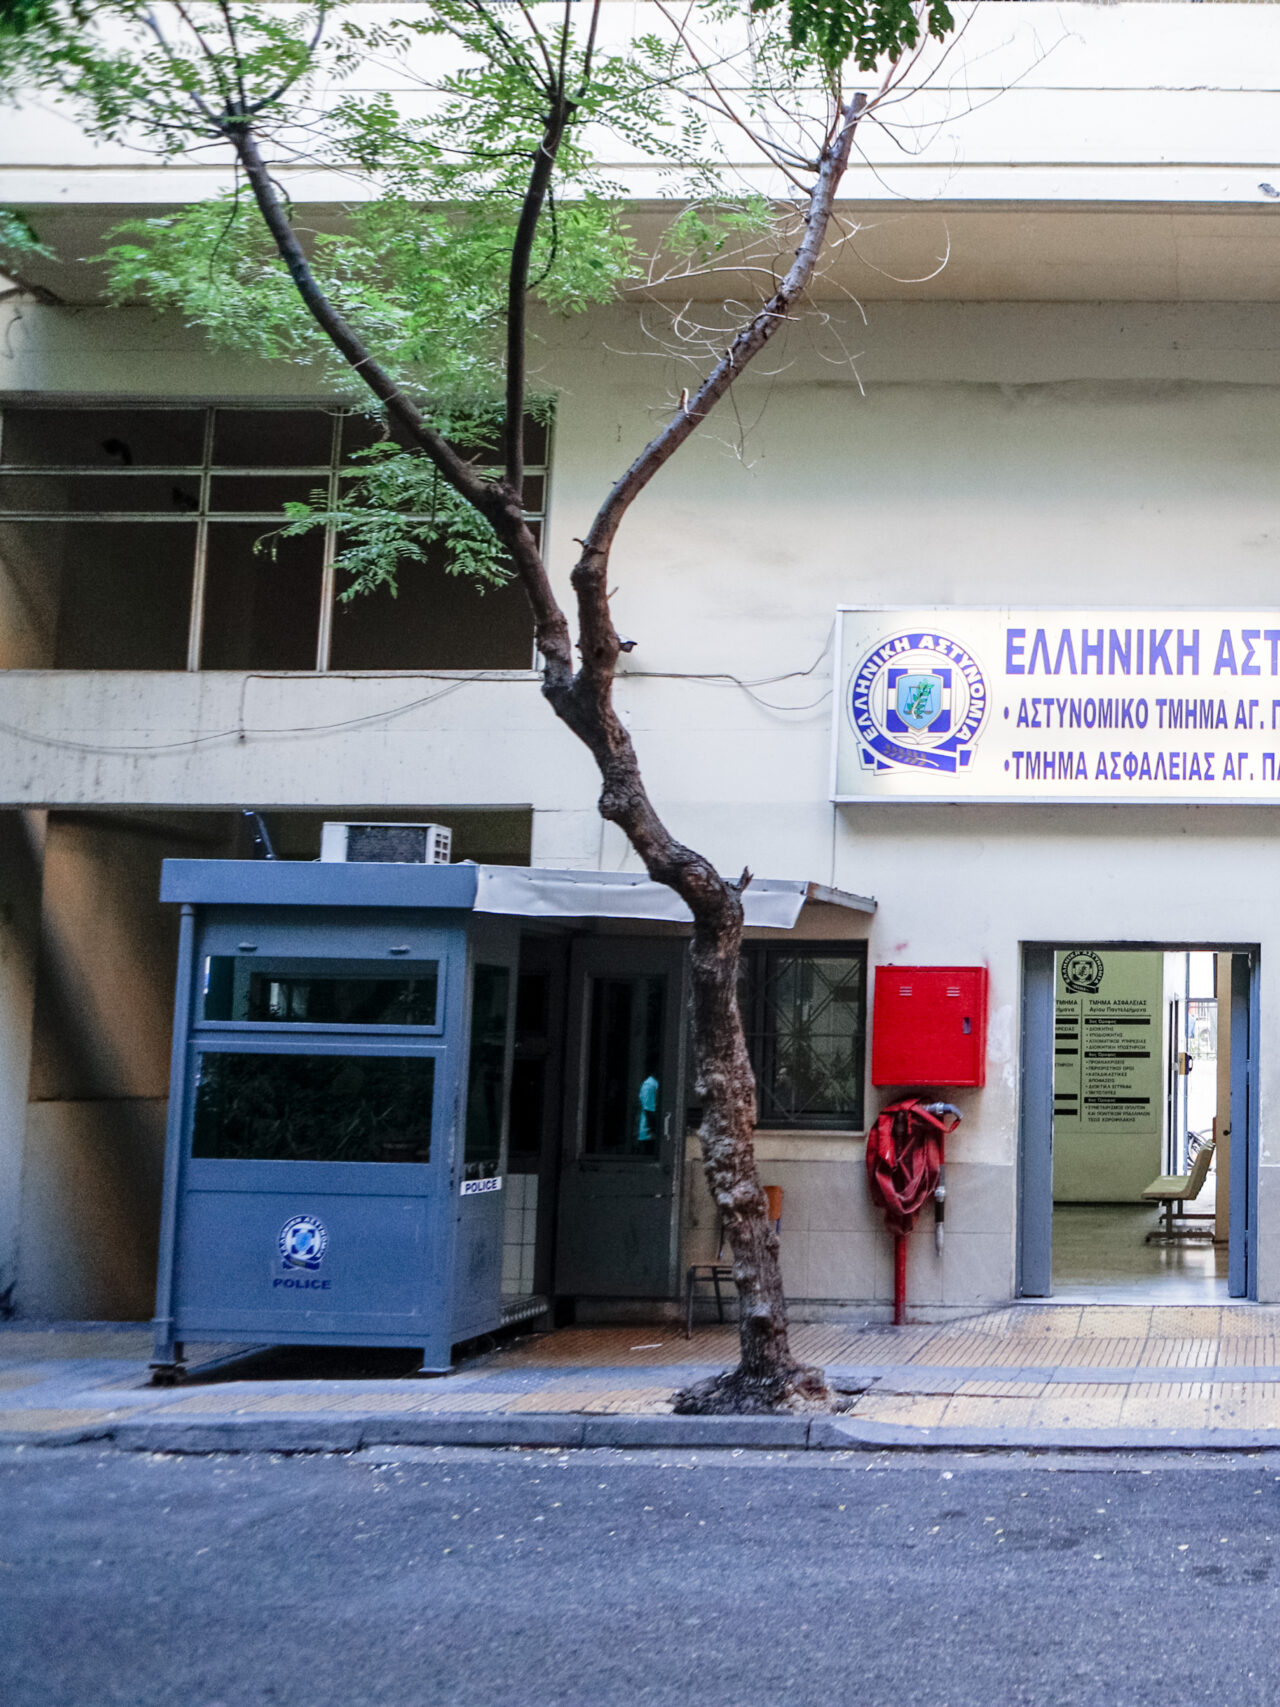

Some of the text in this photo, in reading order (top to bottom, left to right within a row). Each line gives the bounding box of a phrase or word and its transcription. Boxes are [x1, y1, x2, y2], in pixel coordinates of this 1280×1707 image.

[1006, 628, 1200, 675] ΕΛΛΗΝΙΚΗ
[853, 635, 985, 741] ΕΛΛΗΝΙΚΗ ΑΣΤΥΝΟΜΙΑ
[1016, 697, 1149, 729] ΑΣΤΥΝΟΜΙΚΟ
[1155, 698, 1229, 730] ΤΜΗΜΑ
[1012, 751, 1088, 780] ΤΜΗΜΑ
[1095, 751, 1215, 781] ΑΣΦΑΛΕΙΑΣ
[465, 1179, 498, 1193] POLICE
[273, 1278, 332, 1290] POLICE
